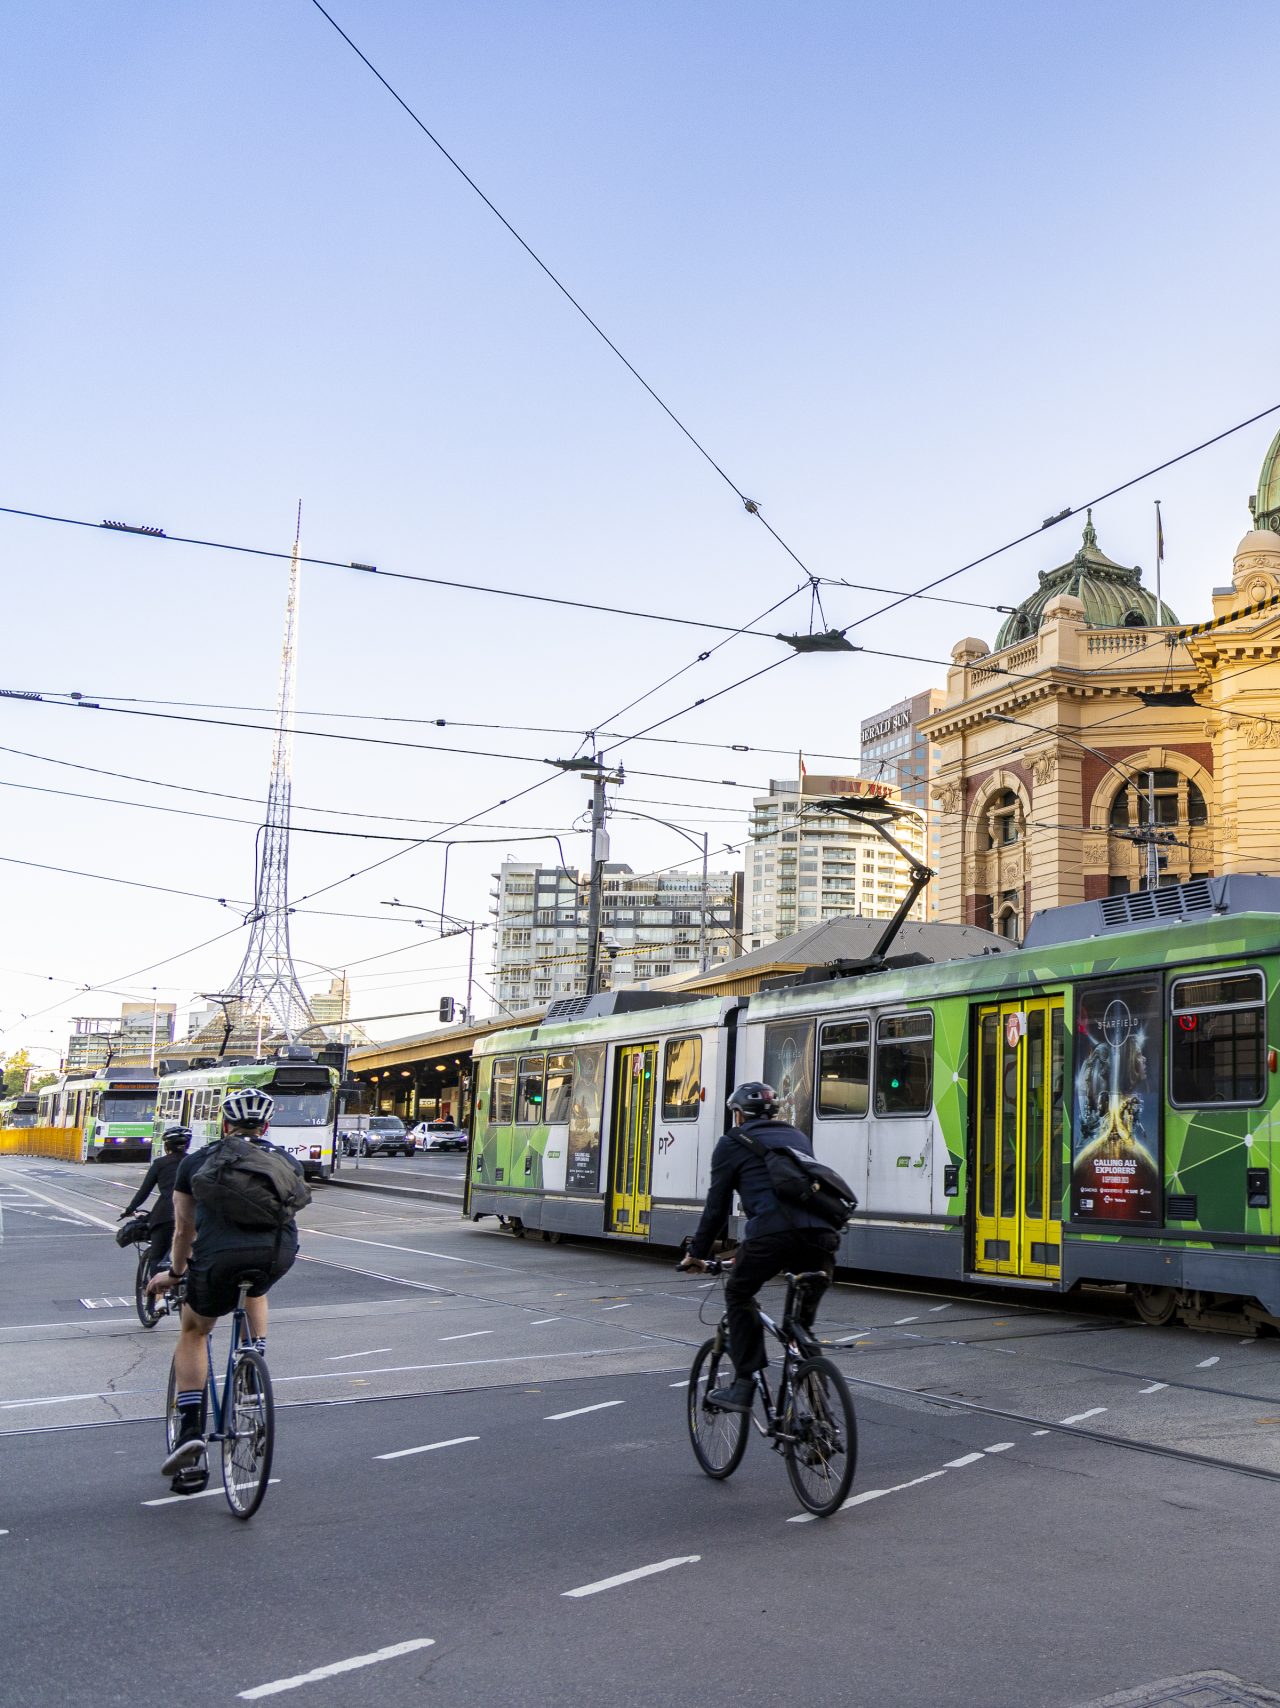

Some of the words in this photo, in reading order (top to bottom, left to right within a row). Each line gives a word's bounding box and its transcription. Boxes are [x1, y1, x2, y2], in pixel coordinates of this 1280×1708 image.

[861, 720, 891, 741] HERALD
[892, 711, 910, 730] SUN
[831, 779, 861, 793] QUAY
[868, 783, 893, 798] WEST
[1097, 1018, 1139, 1030] STARFIELD
[1093, 1159, 1124, 1167] CALLING
[1124, 1159, 1137, 1167] ALL
[1095, 1166, 1136, 1174] EXPLORERS
